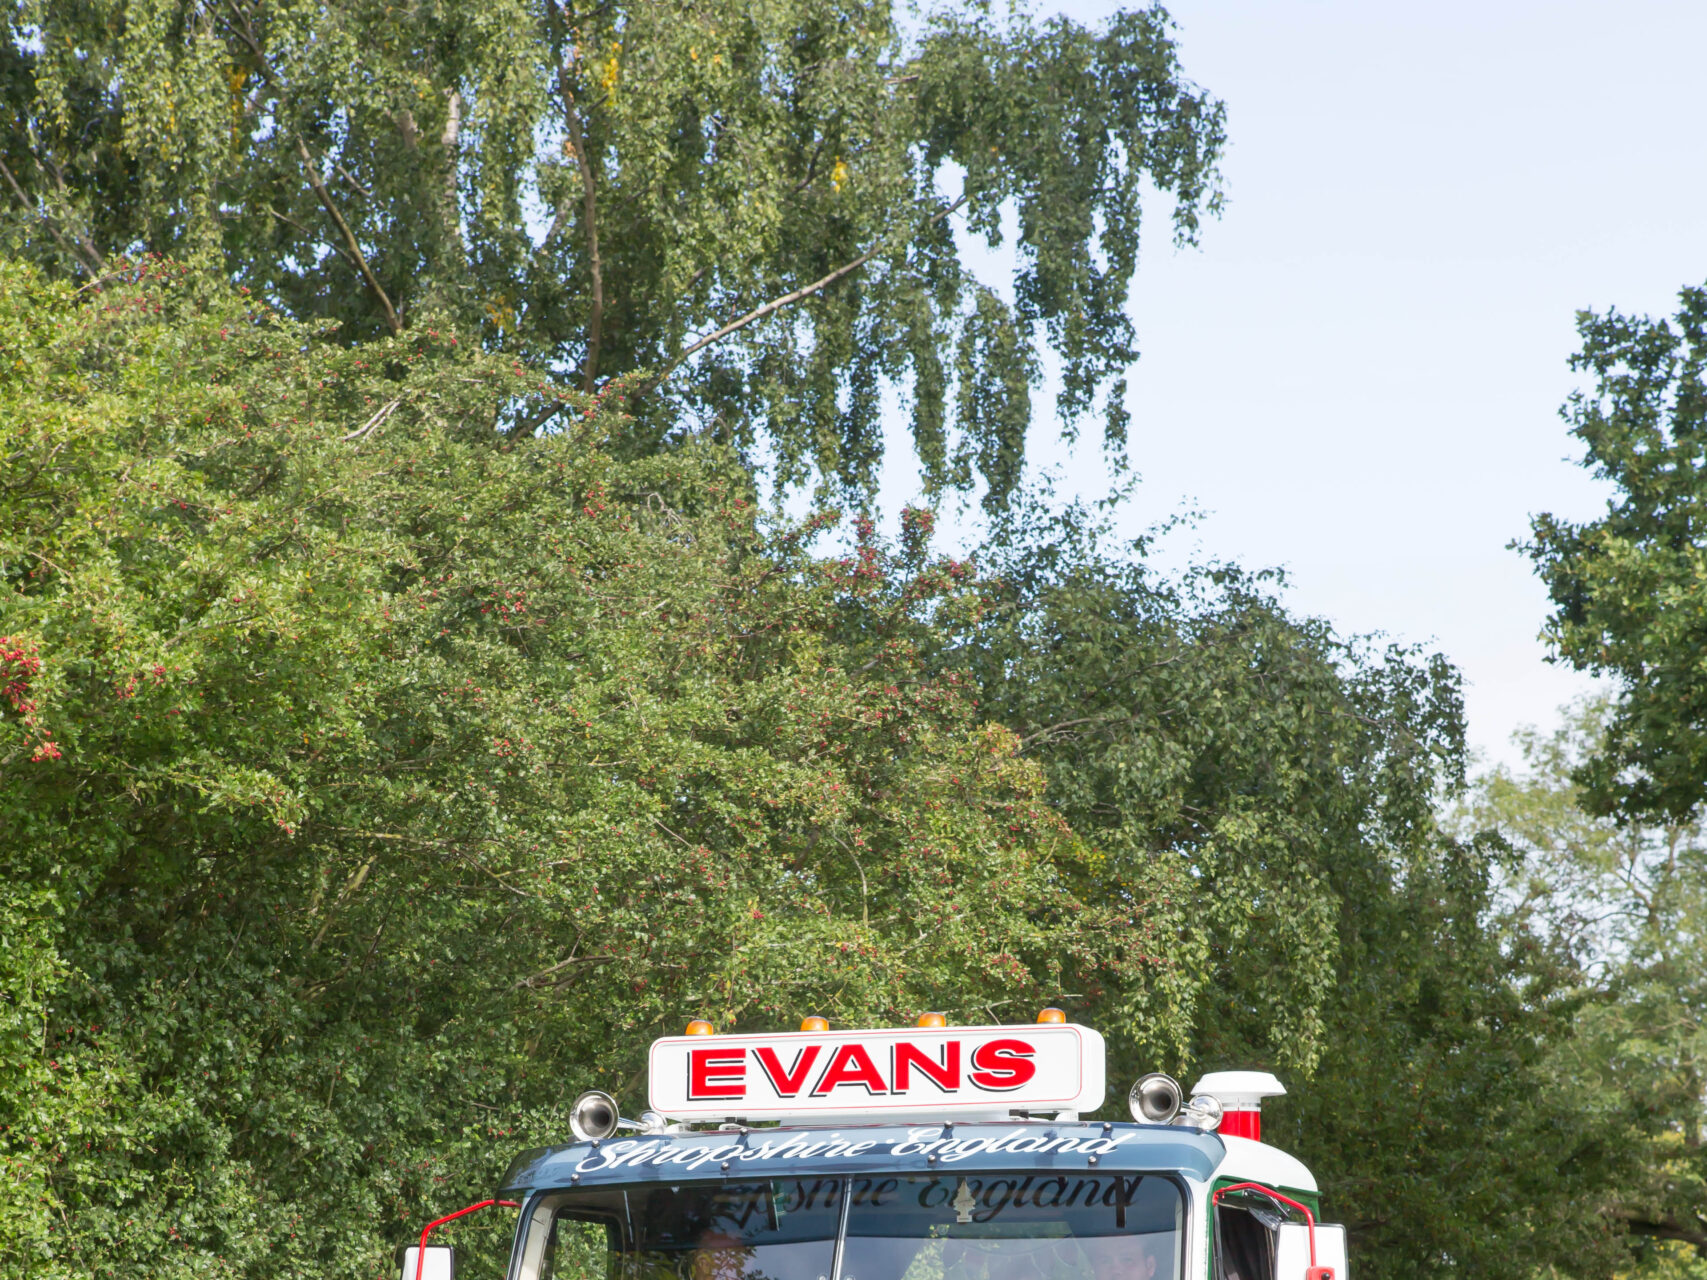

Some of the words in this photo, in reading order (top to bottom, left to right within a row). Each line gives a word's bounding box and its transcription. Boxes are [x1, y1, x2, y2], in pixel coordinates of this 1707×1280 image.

[687, 1039, 1037, 1101] EVANS
[575, 1131, 879, 1174] Shropshire
[890, 1126, 1137, 1162] England
